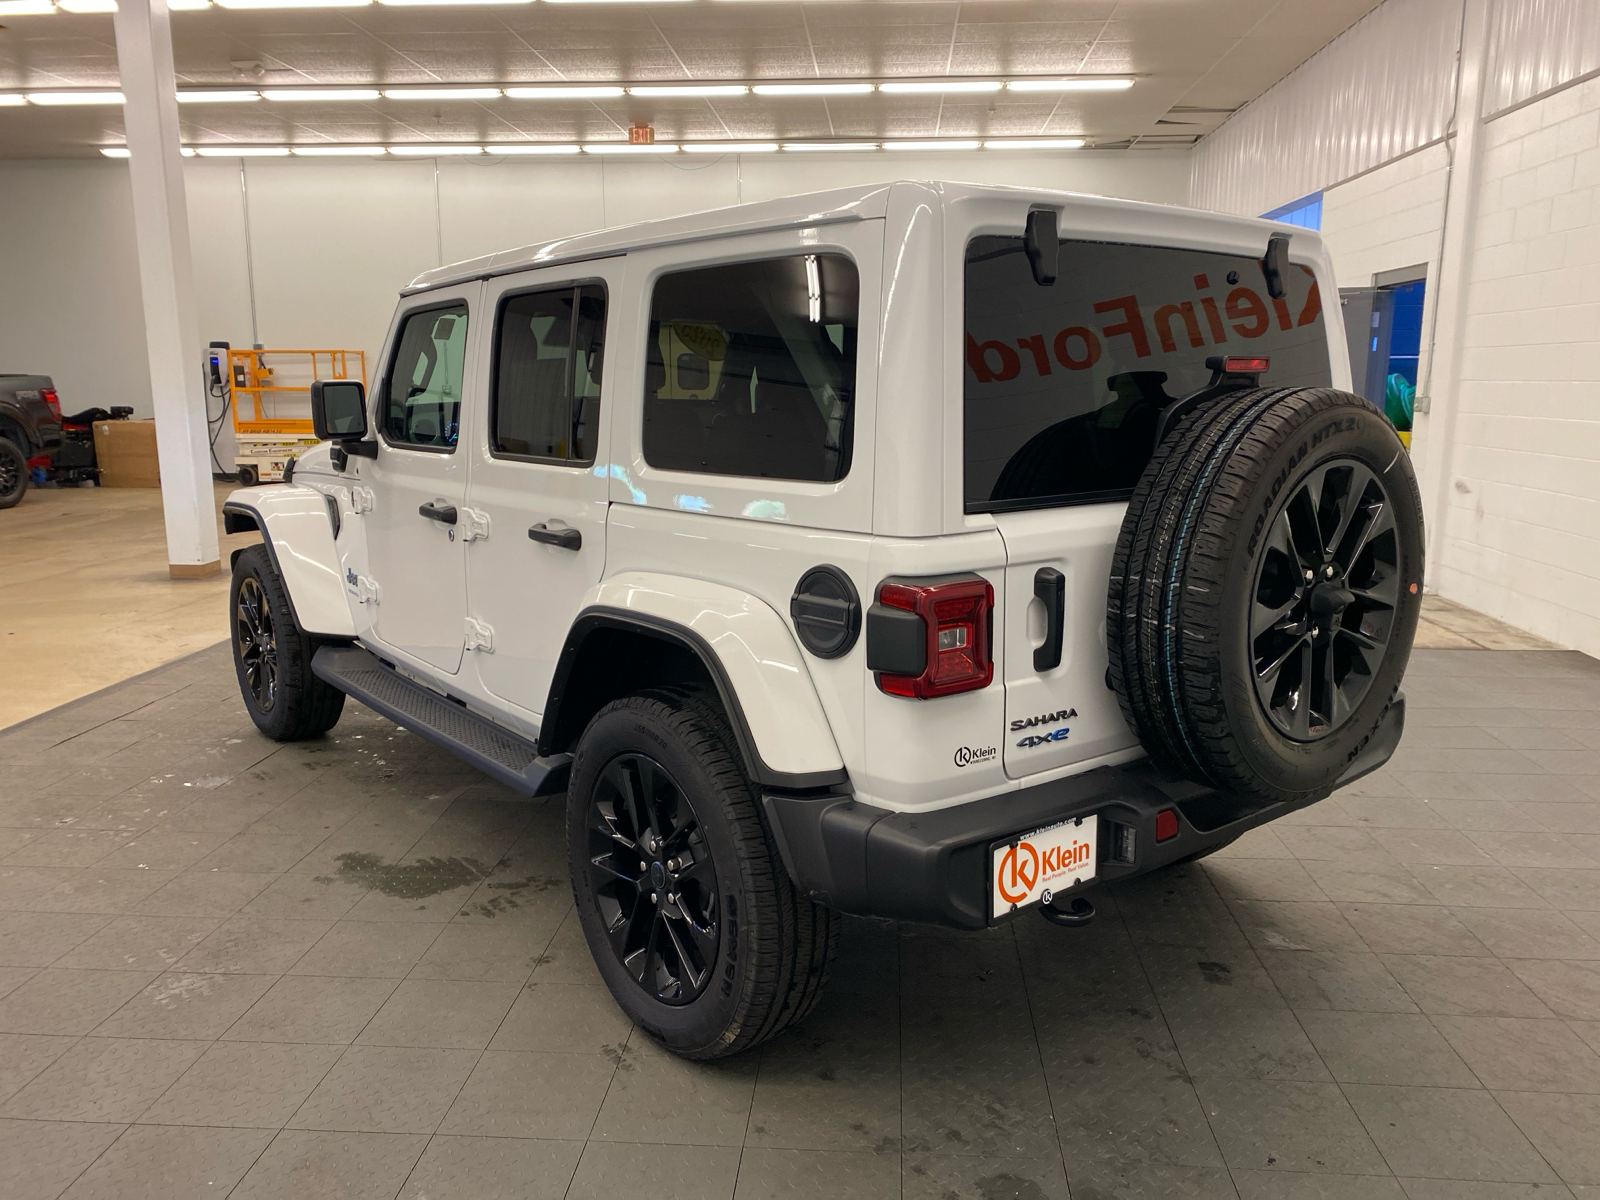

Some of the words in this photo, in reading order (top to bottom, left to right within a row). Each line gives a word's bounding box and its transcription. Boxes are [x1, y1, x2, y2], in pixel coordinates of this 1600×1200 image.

[632, 128, 651, 143] EXIT
[1010, 708, 1078, 731] SAHARA
[972, 746, 996, 759] Klein
[1042, 840, 1089, 875] Klein
